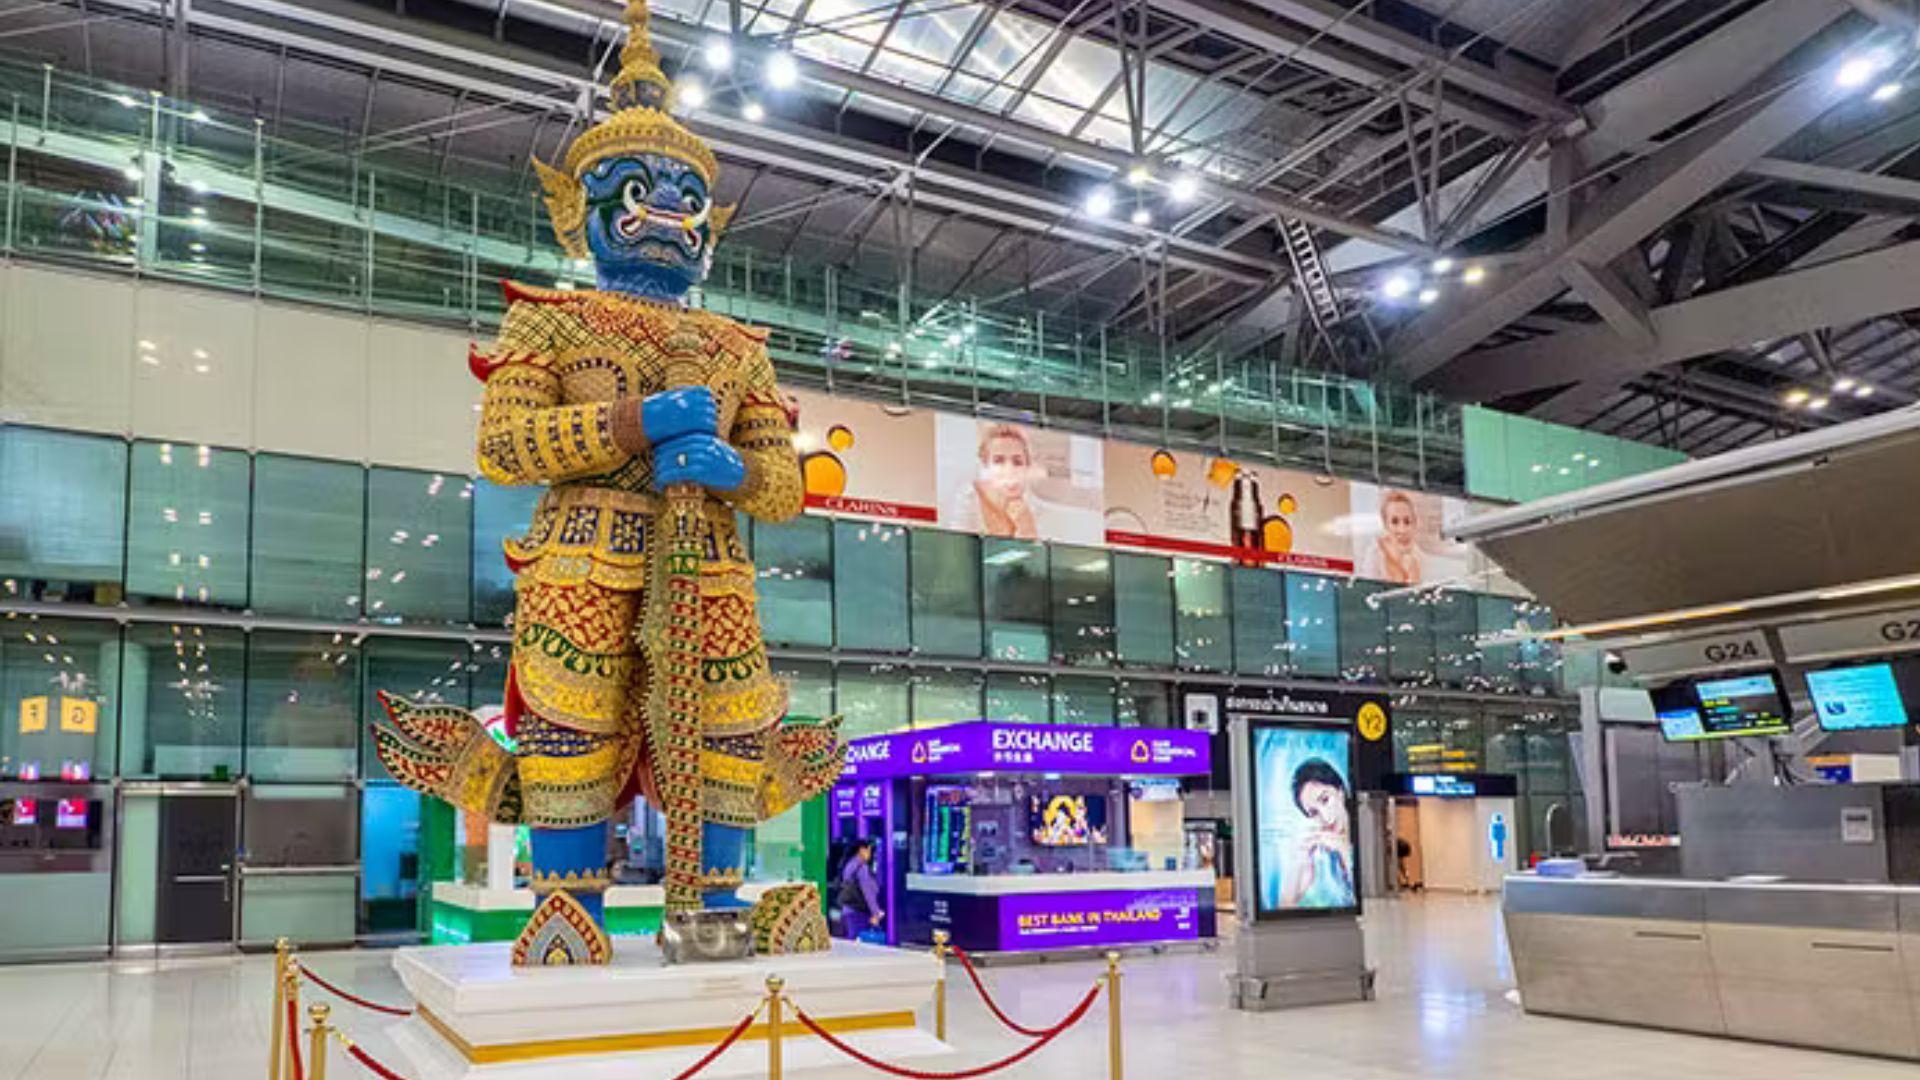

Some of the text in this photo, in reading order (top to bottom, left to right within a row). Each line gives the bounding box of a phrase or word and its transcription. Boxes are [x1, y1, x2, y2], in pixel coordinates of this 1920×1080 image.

[825, 497, 898, 517] CLARINS
[1704, 640, 1758, 664] G24
[1361, 712, 1382, 732] Y2
[992, 728, 1093, 753] EXCHANGE
[1018, 914, 1048, 928] BEST
[1051, 912, 1084, 926] BANK
[1103, 908, 1162, 923] THAILAND
